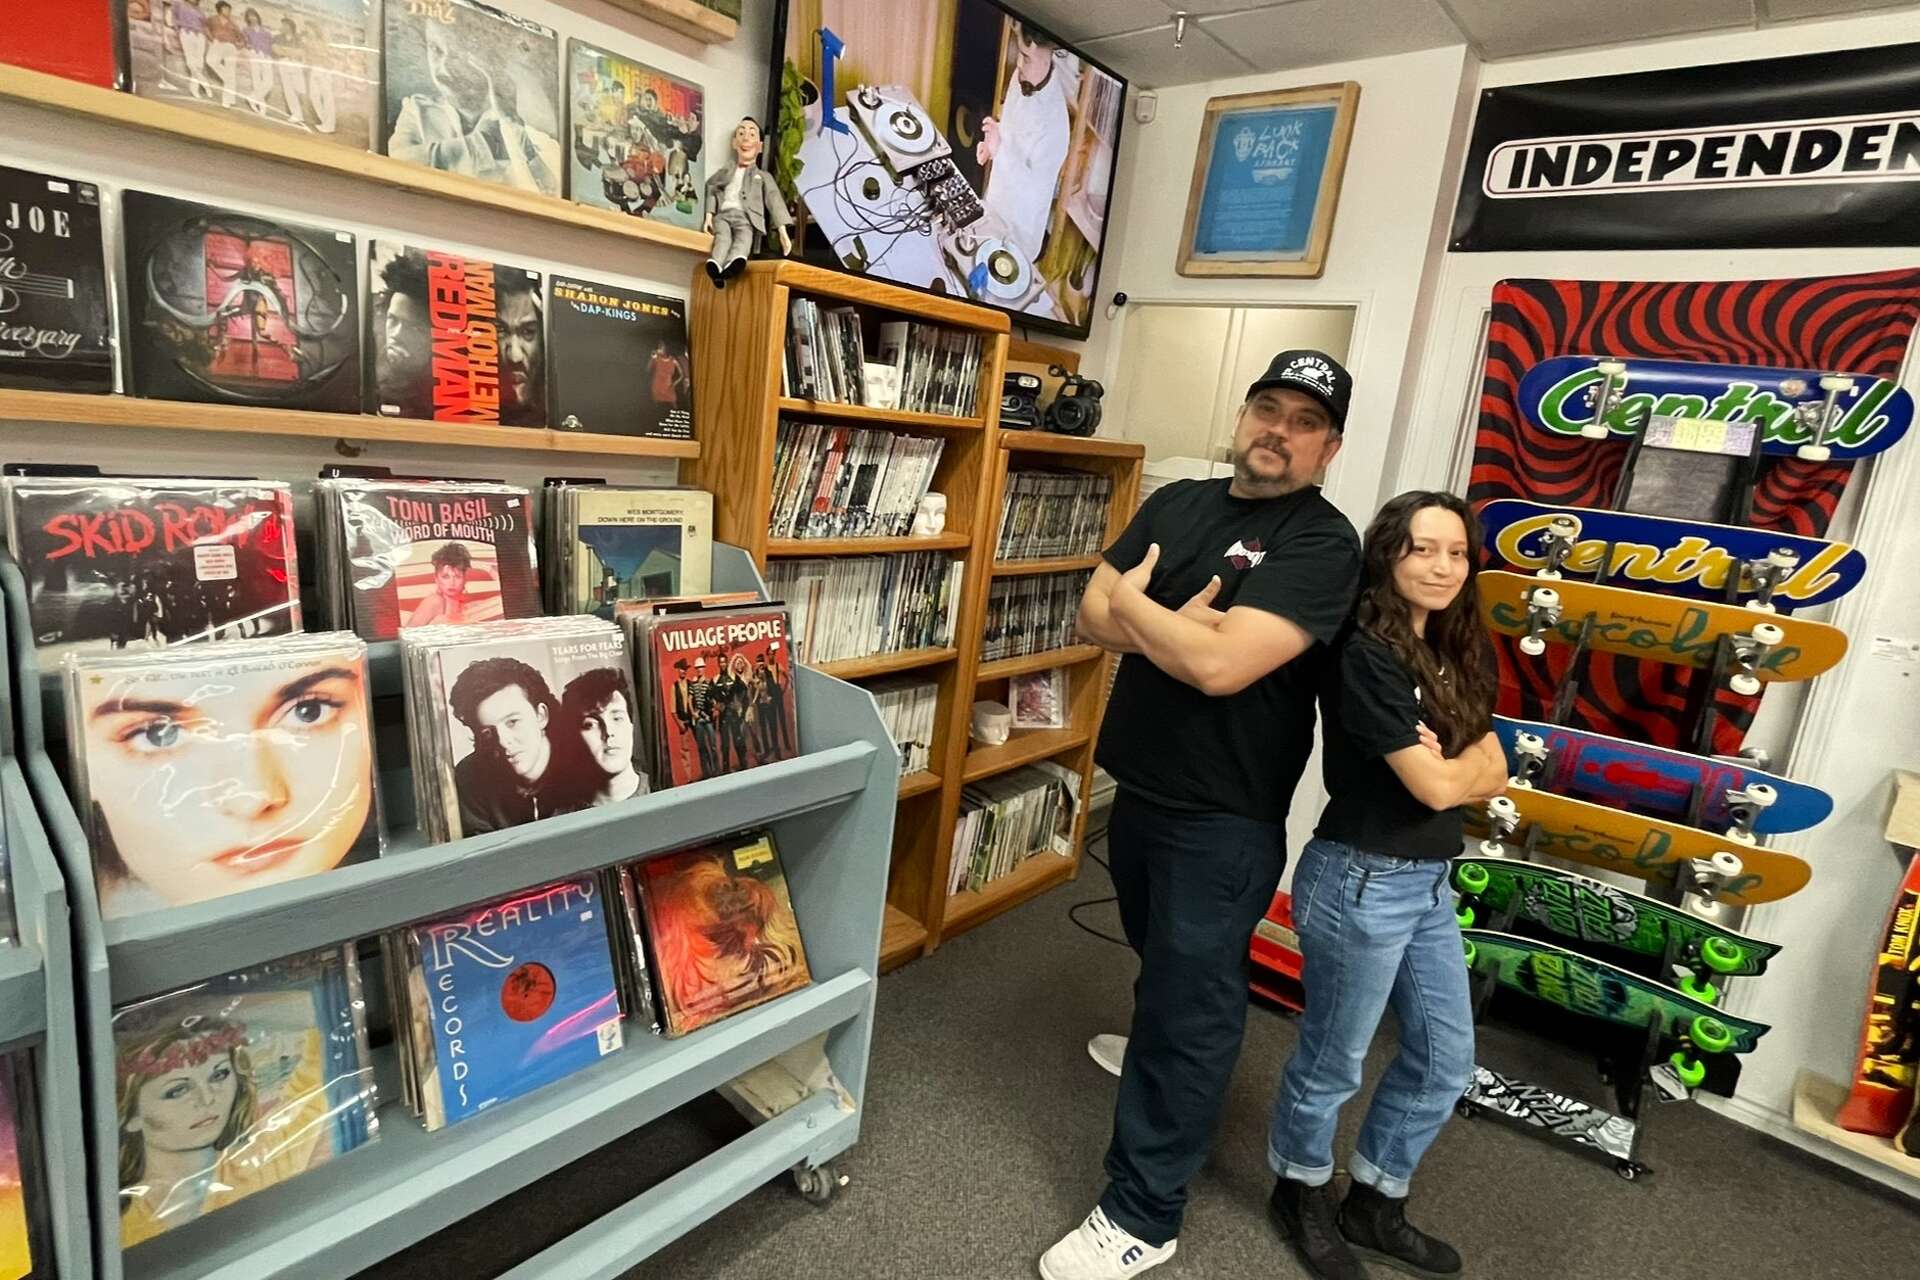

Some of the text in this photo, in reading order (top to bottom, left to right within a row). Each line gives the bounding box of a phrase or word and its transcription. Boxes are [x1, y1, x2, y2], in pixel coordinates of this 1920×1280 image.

[5, 202, 71, 238] JOE
[554, 286, 619, 307] SHARON
[622, 301, 669, 316] JONES
[580, 303, 637, 321] DAP-KINGS
[426, 250, 470, 424] REDMAN
[1290, 356, 1336, 384] CENTRAL
[332, 468, 340, 478] U
[385, 495, 492, 523] TONI BASIL
[433, 523, 449, 538] OF
[451, 523, 495, 543] MOUTH
[552, 644, 579, 655] TEARS
[579, 643, 598, 653] FOR
[662, 626, 726, 652] VILLAGE
[728, 619, 782, 643] PEOPLE
[429, 882, 594, 971] REALITY
[1888, 907, 1915, 954] TOM KNOX
